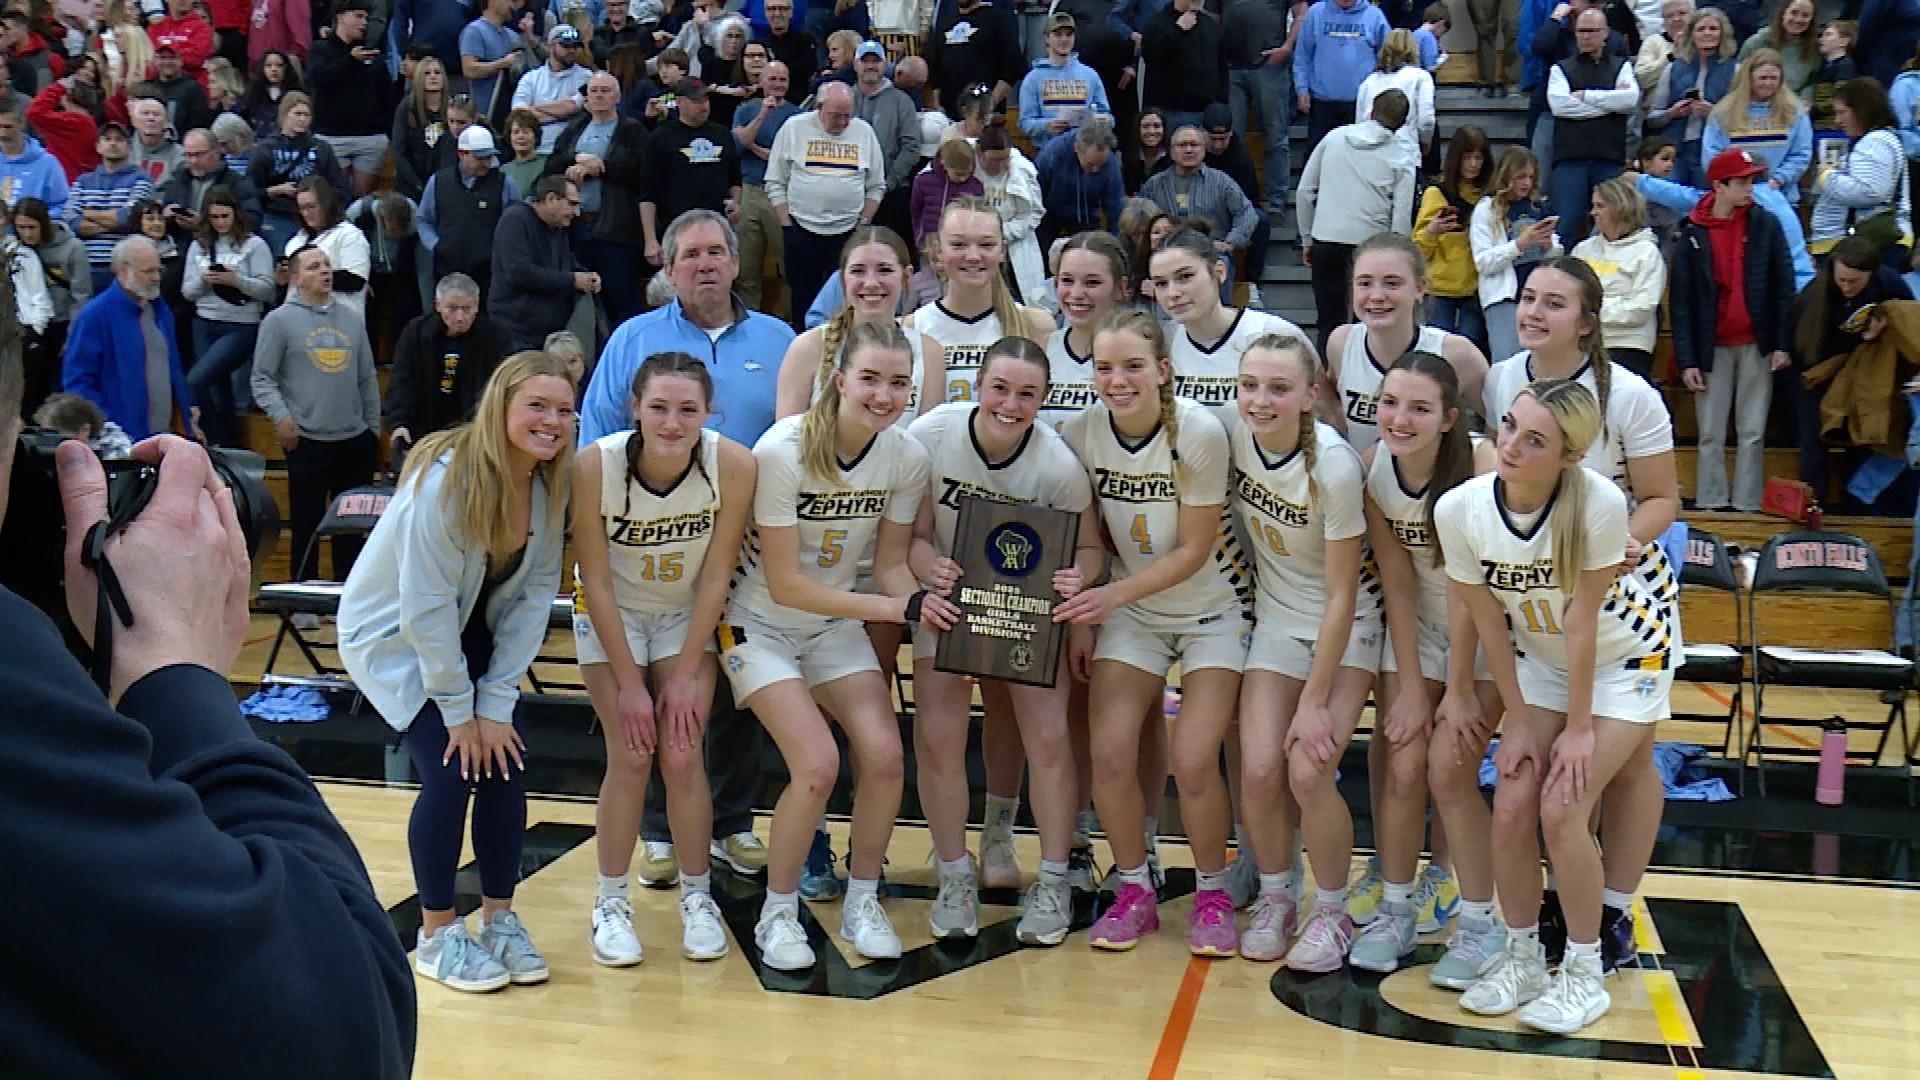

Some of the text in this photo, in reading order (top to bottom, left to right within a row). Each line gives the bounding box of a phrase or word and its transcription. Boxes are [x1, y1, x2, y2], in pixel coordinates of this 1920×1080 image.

[807, 140, 859, 160] ZEPHYRS
[1174, 376, 1238, 401] ZEPHY
[1096, 468, 1175, 498] ZEPHYRS
[1235, 468, 1308, 525] ZEPHYRS
[610, 515, 711, 543] ZEPHYRS
[1130, 513, 1153, 554] 4
[817, 529, 849, 568] 5
[641, 551, 685, 582] 15
[1481, 559, 1553, 588] ZEPHY
[960, 587, 1052, 615] SECTIONAL CHAMPION
[966, 613, 1038, 633] BASKETBALL
[1519, 599, 1562, 634] 11
[970, 624, 1022, 639] DIVISION
